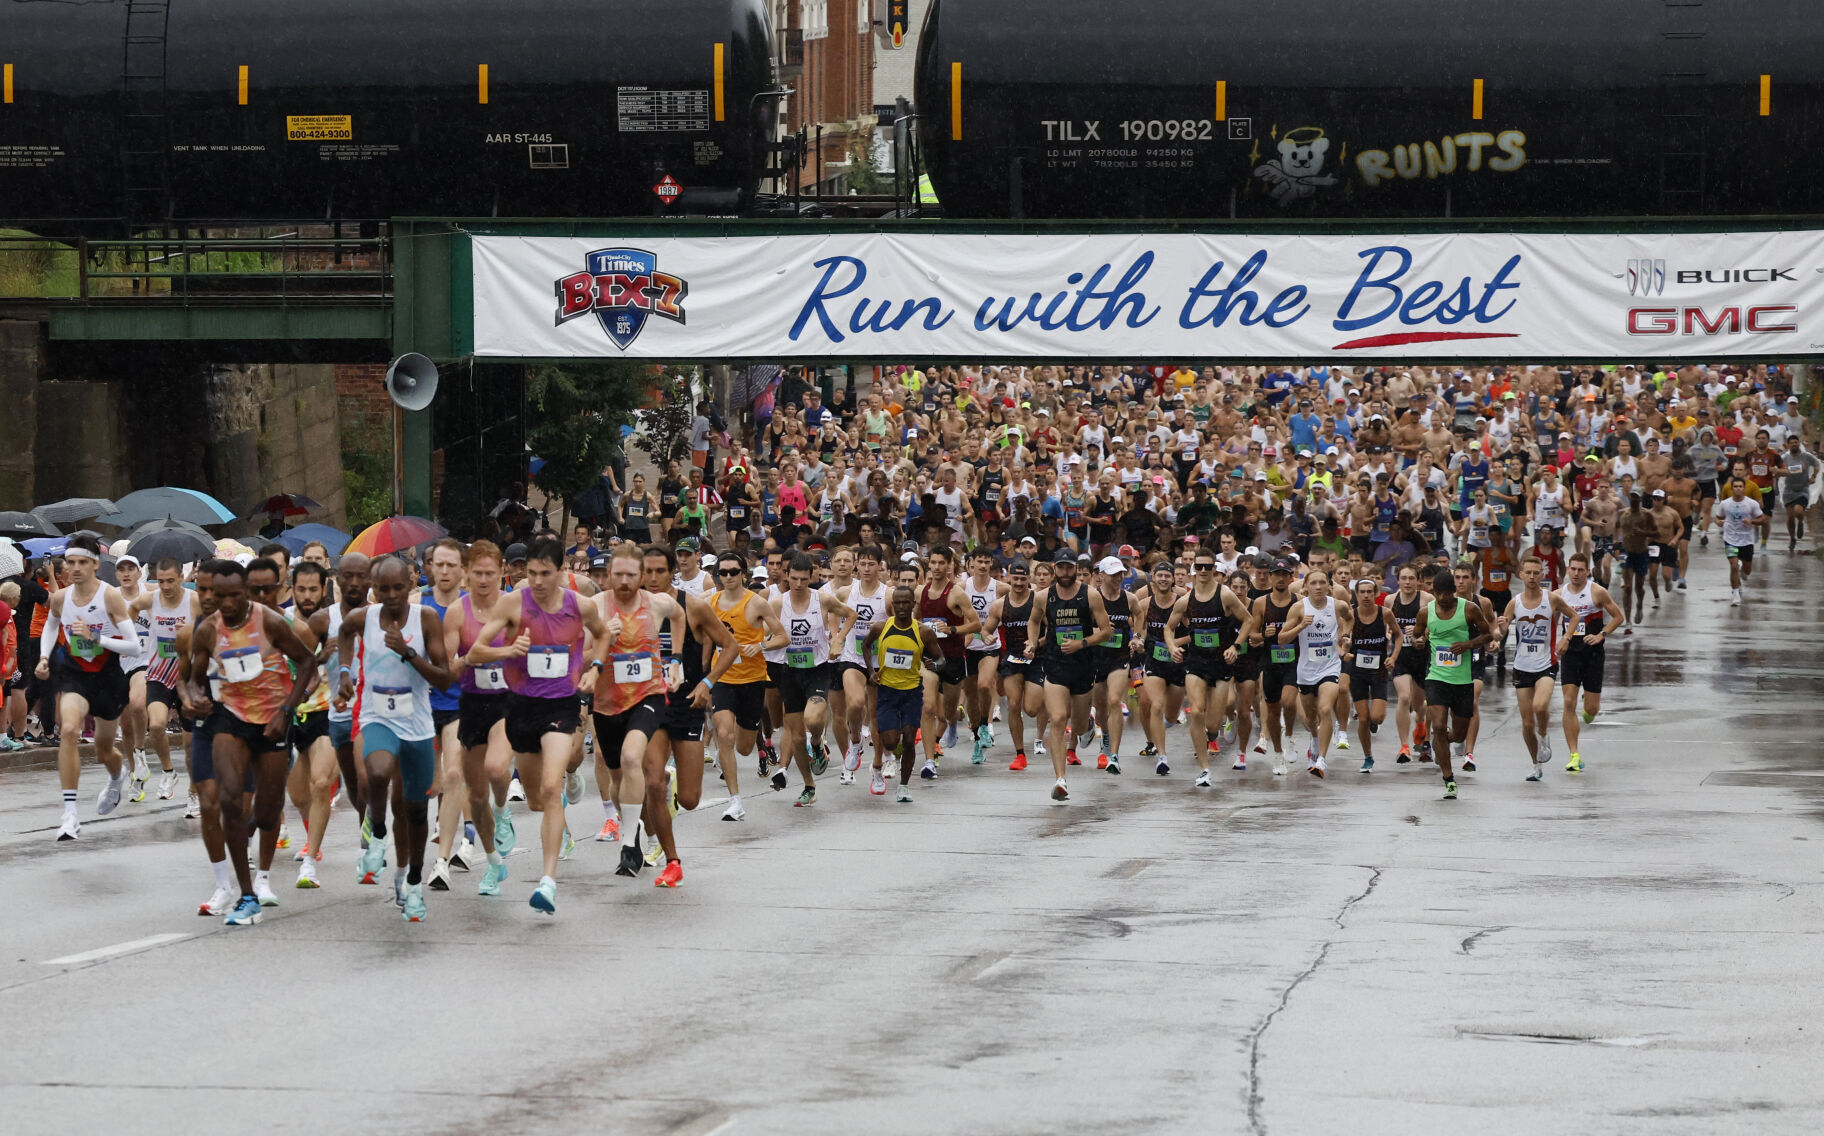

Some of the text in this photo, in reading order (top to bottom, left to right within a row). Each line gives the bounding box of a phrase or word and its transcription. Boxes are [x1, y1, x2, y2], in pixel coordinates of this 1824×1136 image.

[290, 130, 350, 138] 800-424-9300
[1041, 120, 1212, 140] TILX 190982
[1236, 128, 1244, 136] C
[486, 134, 552, 142] AAR ST-445
[1355, 130, 1526, 187] RUNTS
[660, 186, 677, 196] 1987
[596, 255, 644, 272] Times
[1677, 267, 1799, 284] BUICK
[560, 271, 683, 318] BIX 7
[788, 245, 1522, 343] Run with the Best
[1626, 303, 1799, 336] GMC
[616, 322, 630, 334] 1975
[76, 639, 93, 650] 519
[1354, 636, 1386, 644] LOTHAR
[1314, 648, 1327, 656] 138
[1438, 652, 1458, 662] 8044
[545, 658, 552, 669] 7
[792, 654, 808, 664] 554
[892, 655, 906, 665] 137
[238, 660, 246, 672] 1
[626, 663, 640, 676] 29
[490, 672, 498, 682] 9
[388, 698, 395, 710] 3
